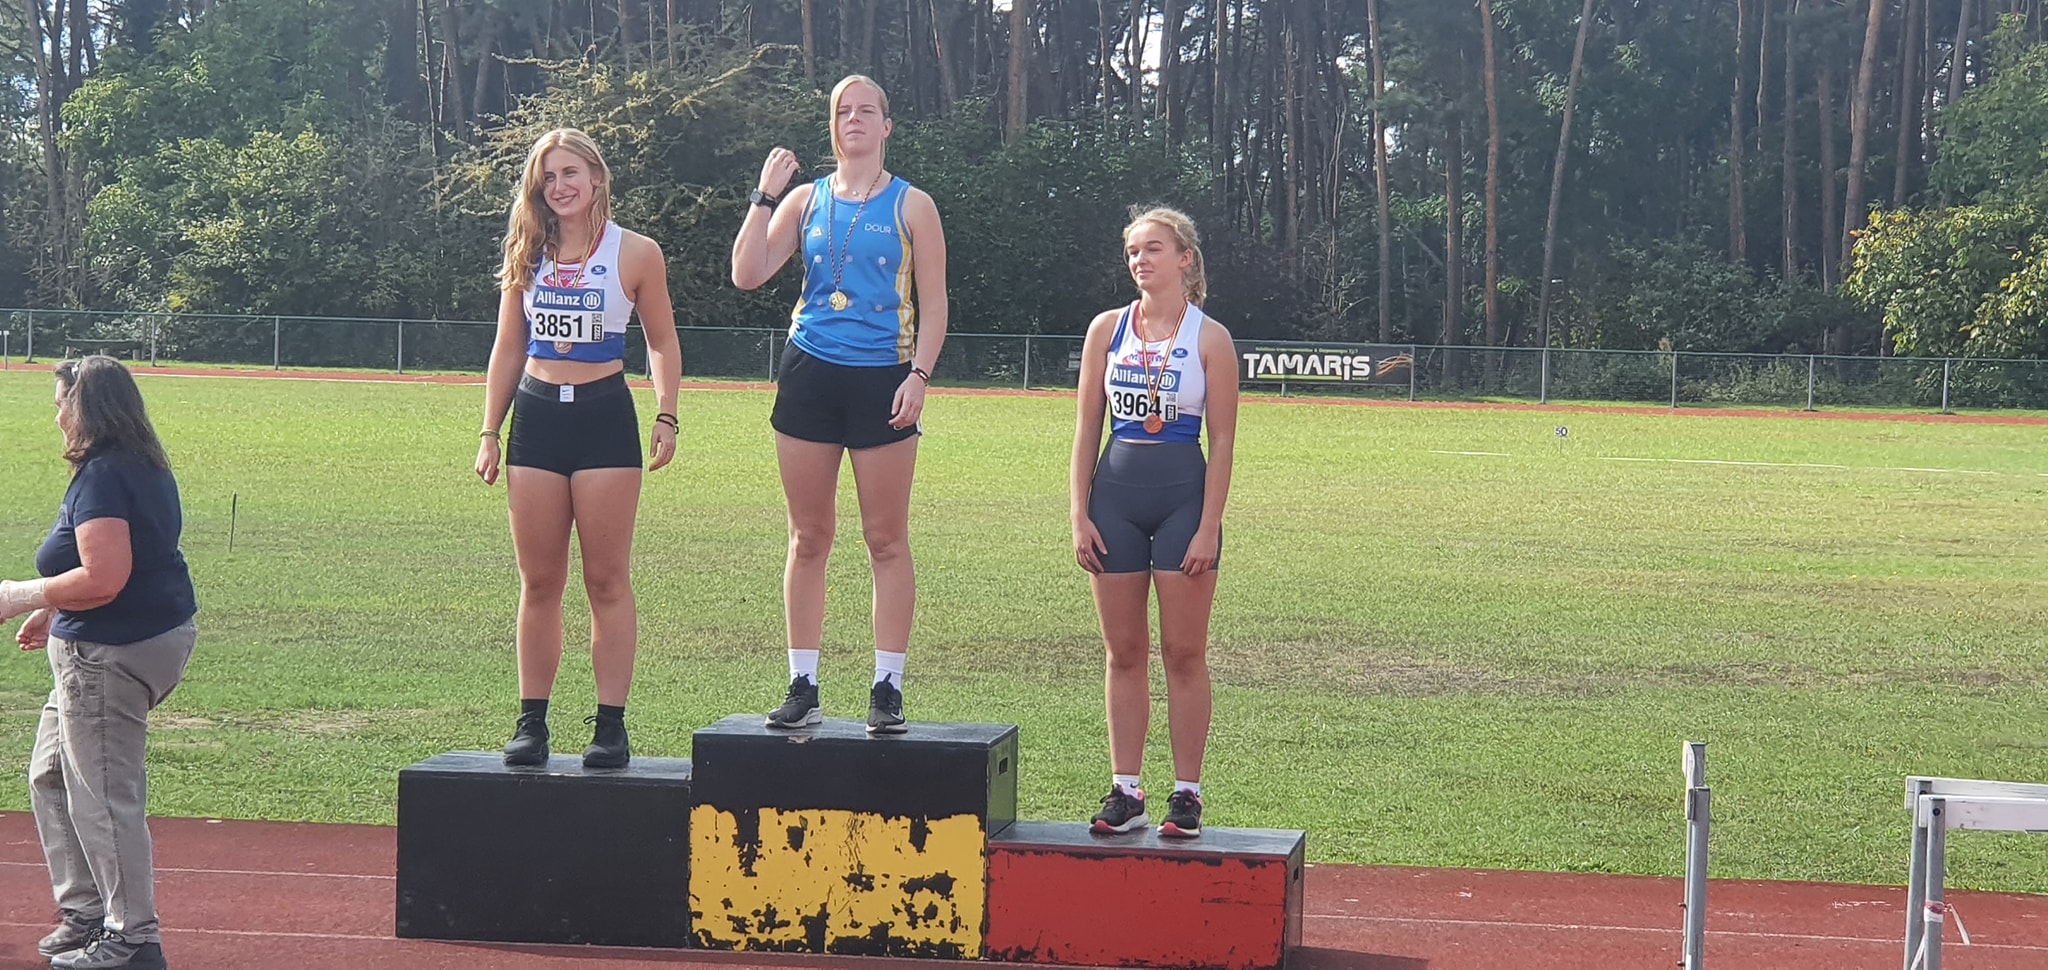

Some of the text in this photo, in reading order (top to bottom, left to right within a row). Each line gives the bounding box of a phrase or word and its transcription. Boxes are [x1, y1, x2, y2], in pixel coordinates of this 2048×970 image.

[864, 223, 891, 234] DOUR
[536, 290, 581, 306] Allianz
[535, 312, 583, 338] 3851
[1111, 368, 1155, 385] Allianz
[1113, 391, 1162, 417] 3964
